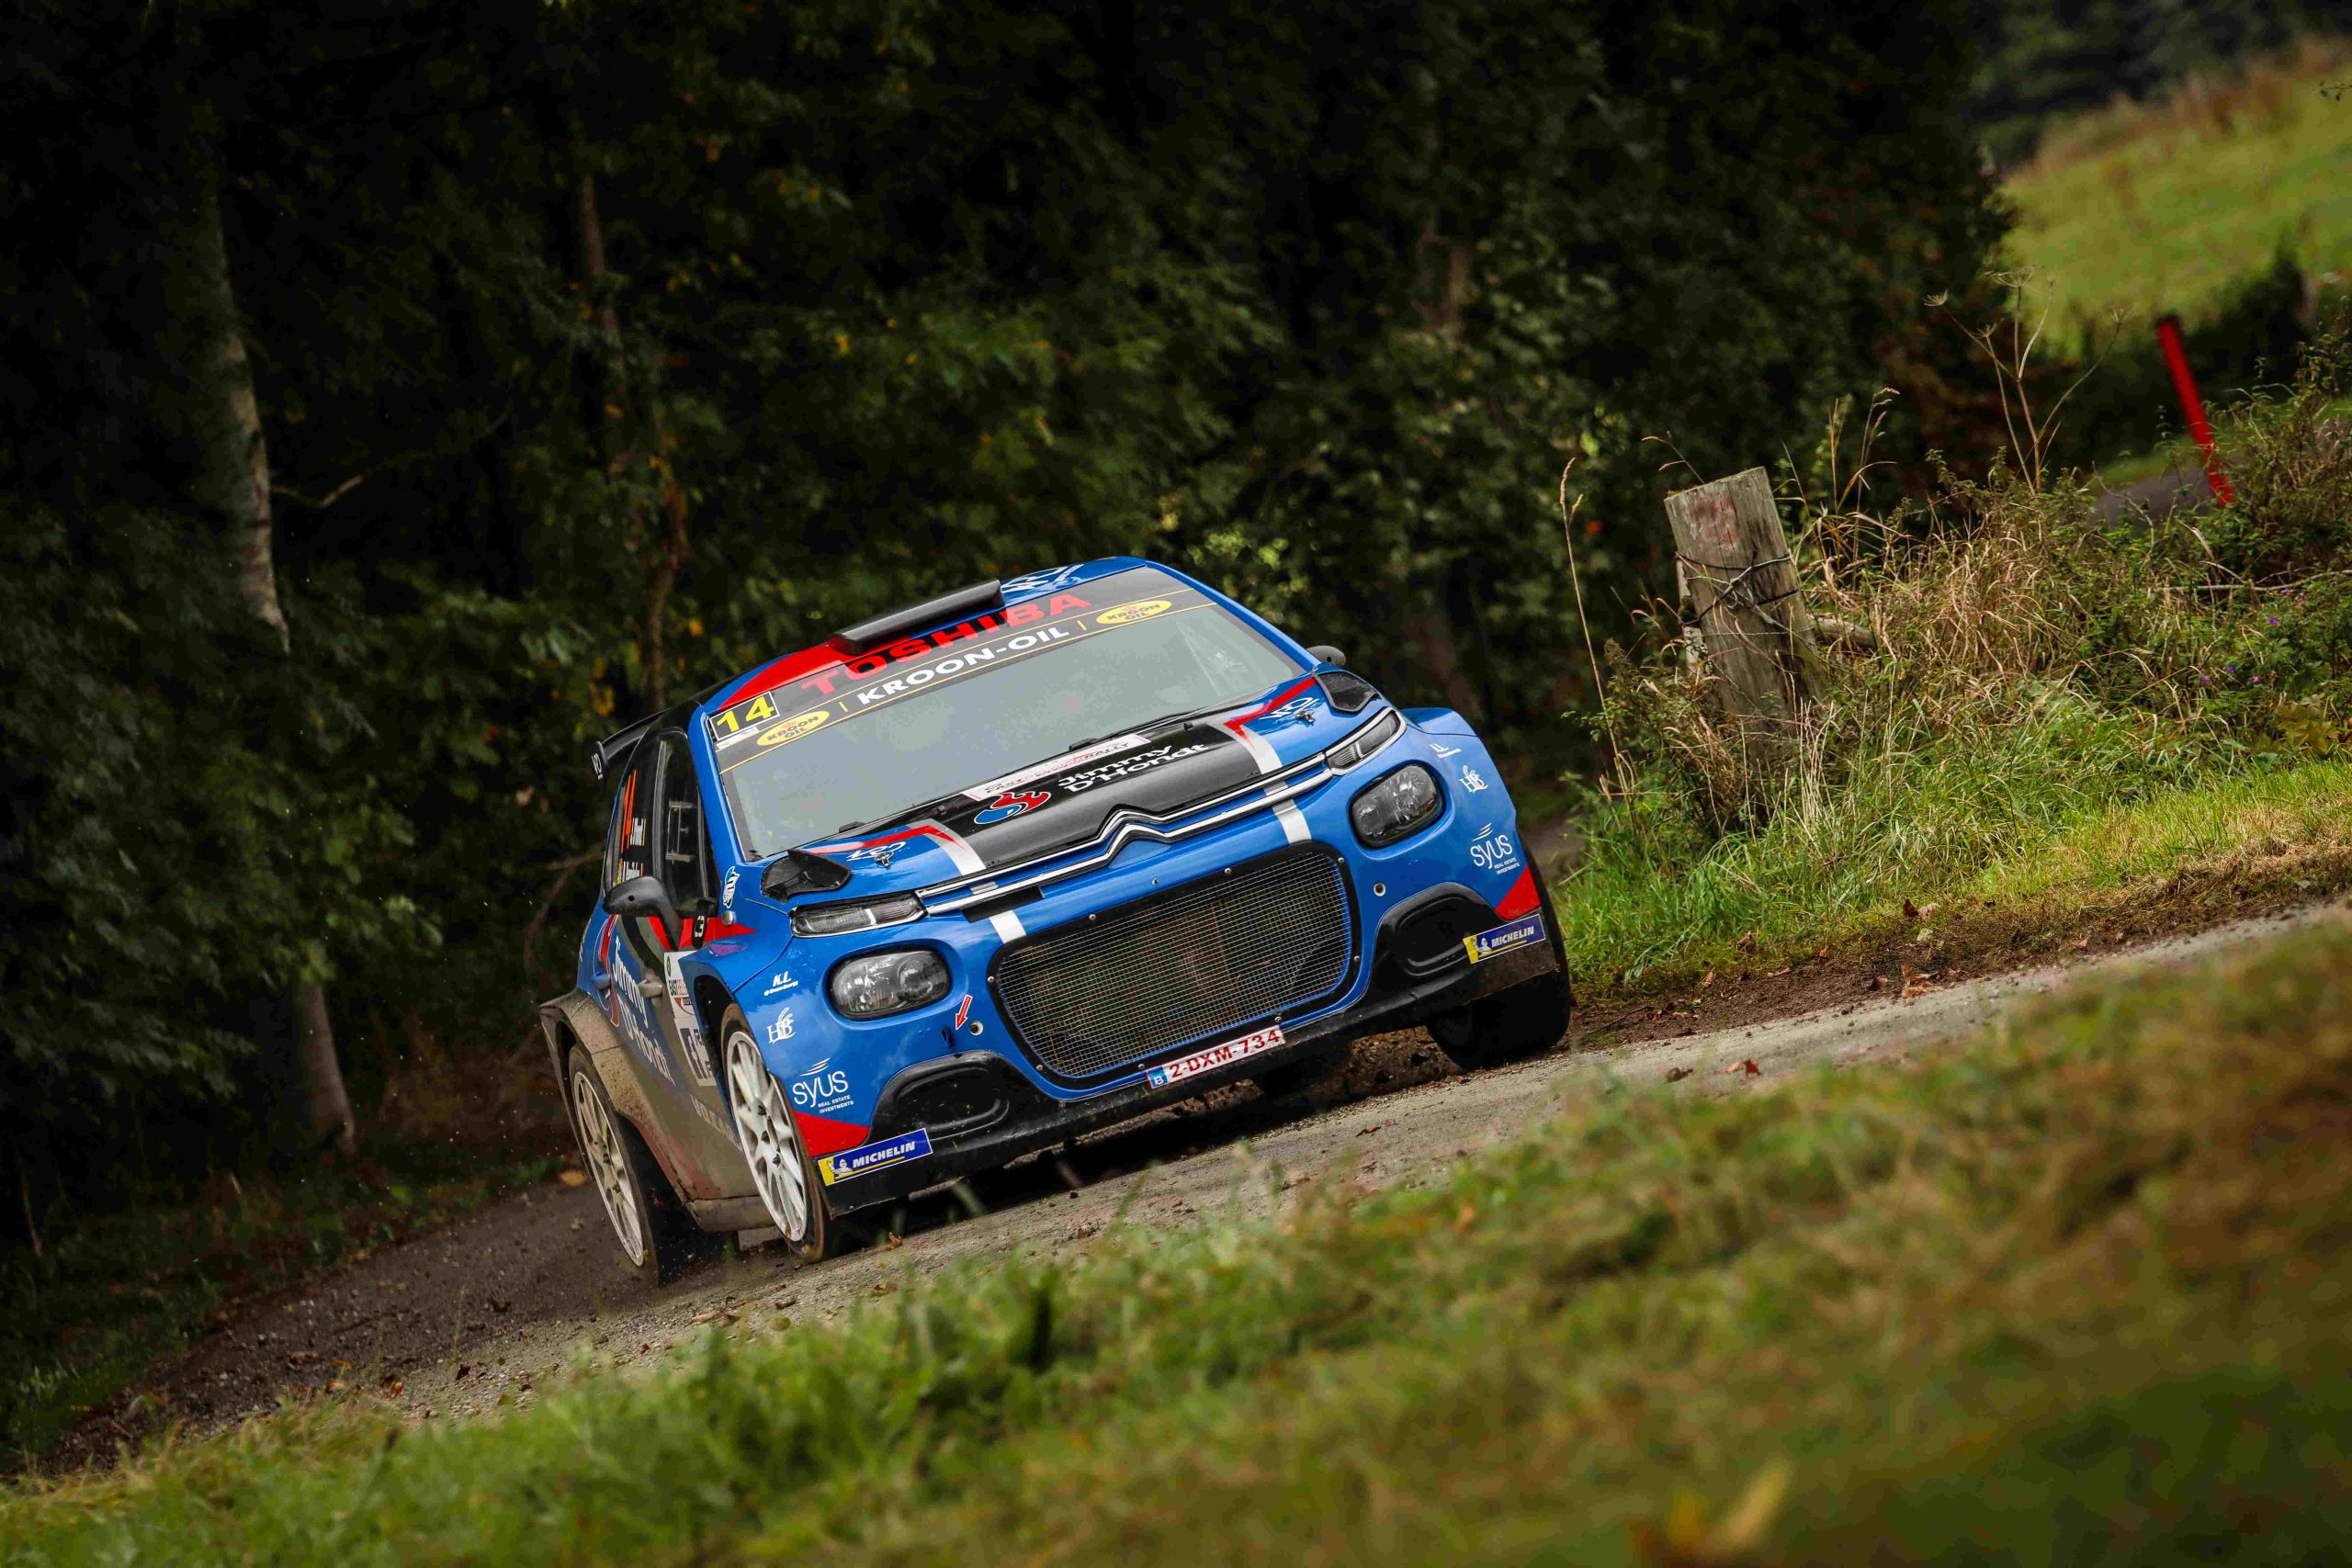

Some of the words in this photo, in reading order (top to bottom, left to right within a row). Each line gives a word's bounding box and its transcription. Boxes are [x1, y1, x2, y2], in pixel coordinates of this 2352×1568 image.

[1107, 604, 1160, 620] KROON
[1125, 612, 1148, 620] OIL
[801, 592, 1092, 695] TOSHIBA
[856, 626, 1070, 705] KROON-OIL
[717, 695, 775, 733] 14
[767, 716, 820, 741] KROON
[785, 727, 809, 739] OIL
[1058, 745, 1172, 786] Jimmy
[1491, 926, 1534, 948] MICHELIN
[1153, 1076, 1165, 1086] B
[1169, 1030, 1281, 1078] 2-DXM-734
[853, 1141, 916, 1168] MICHELIN
